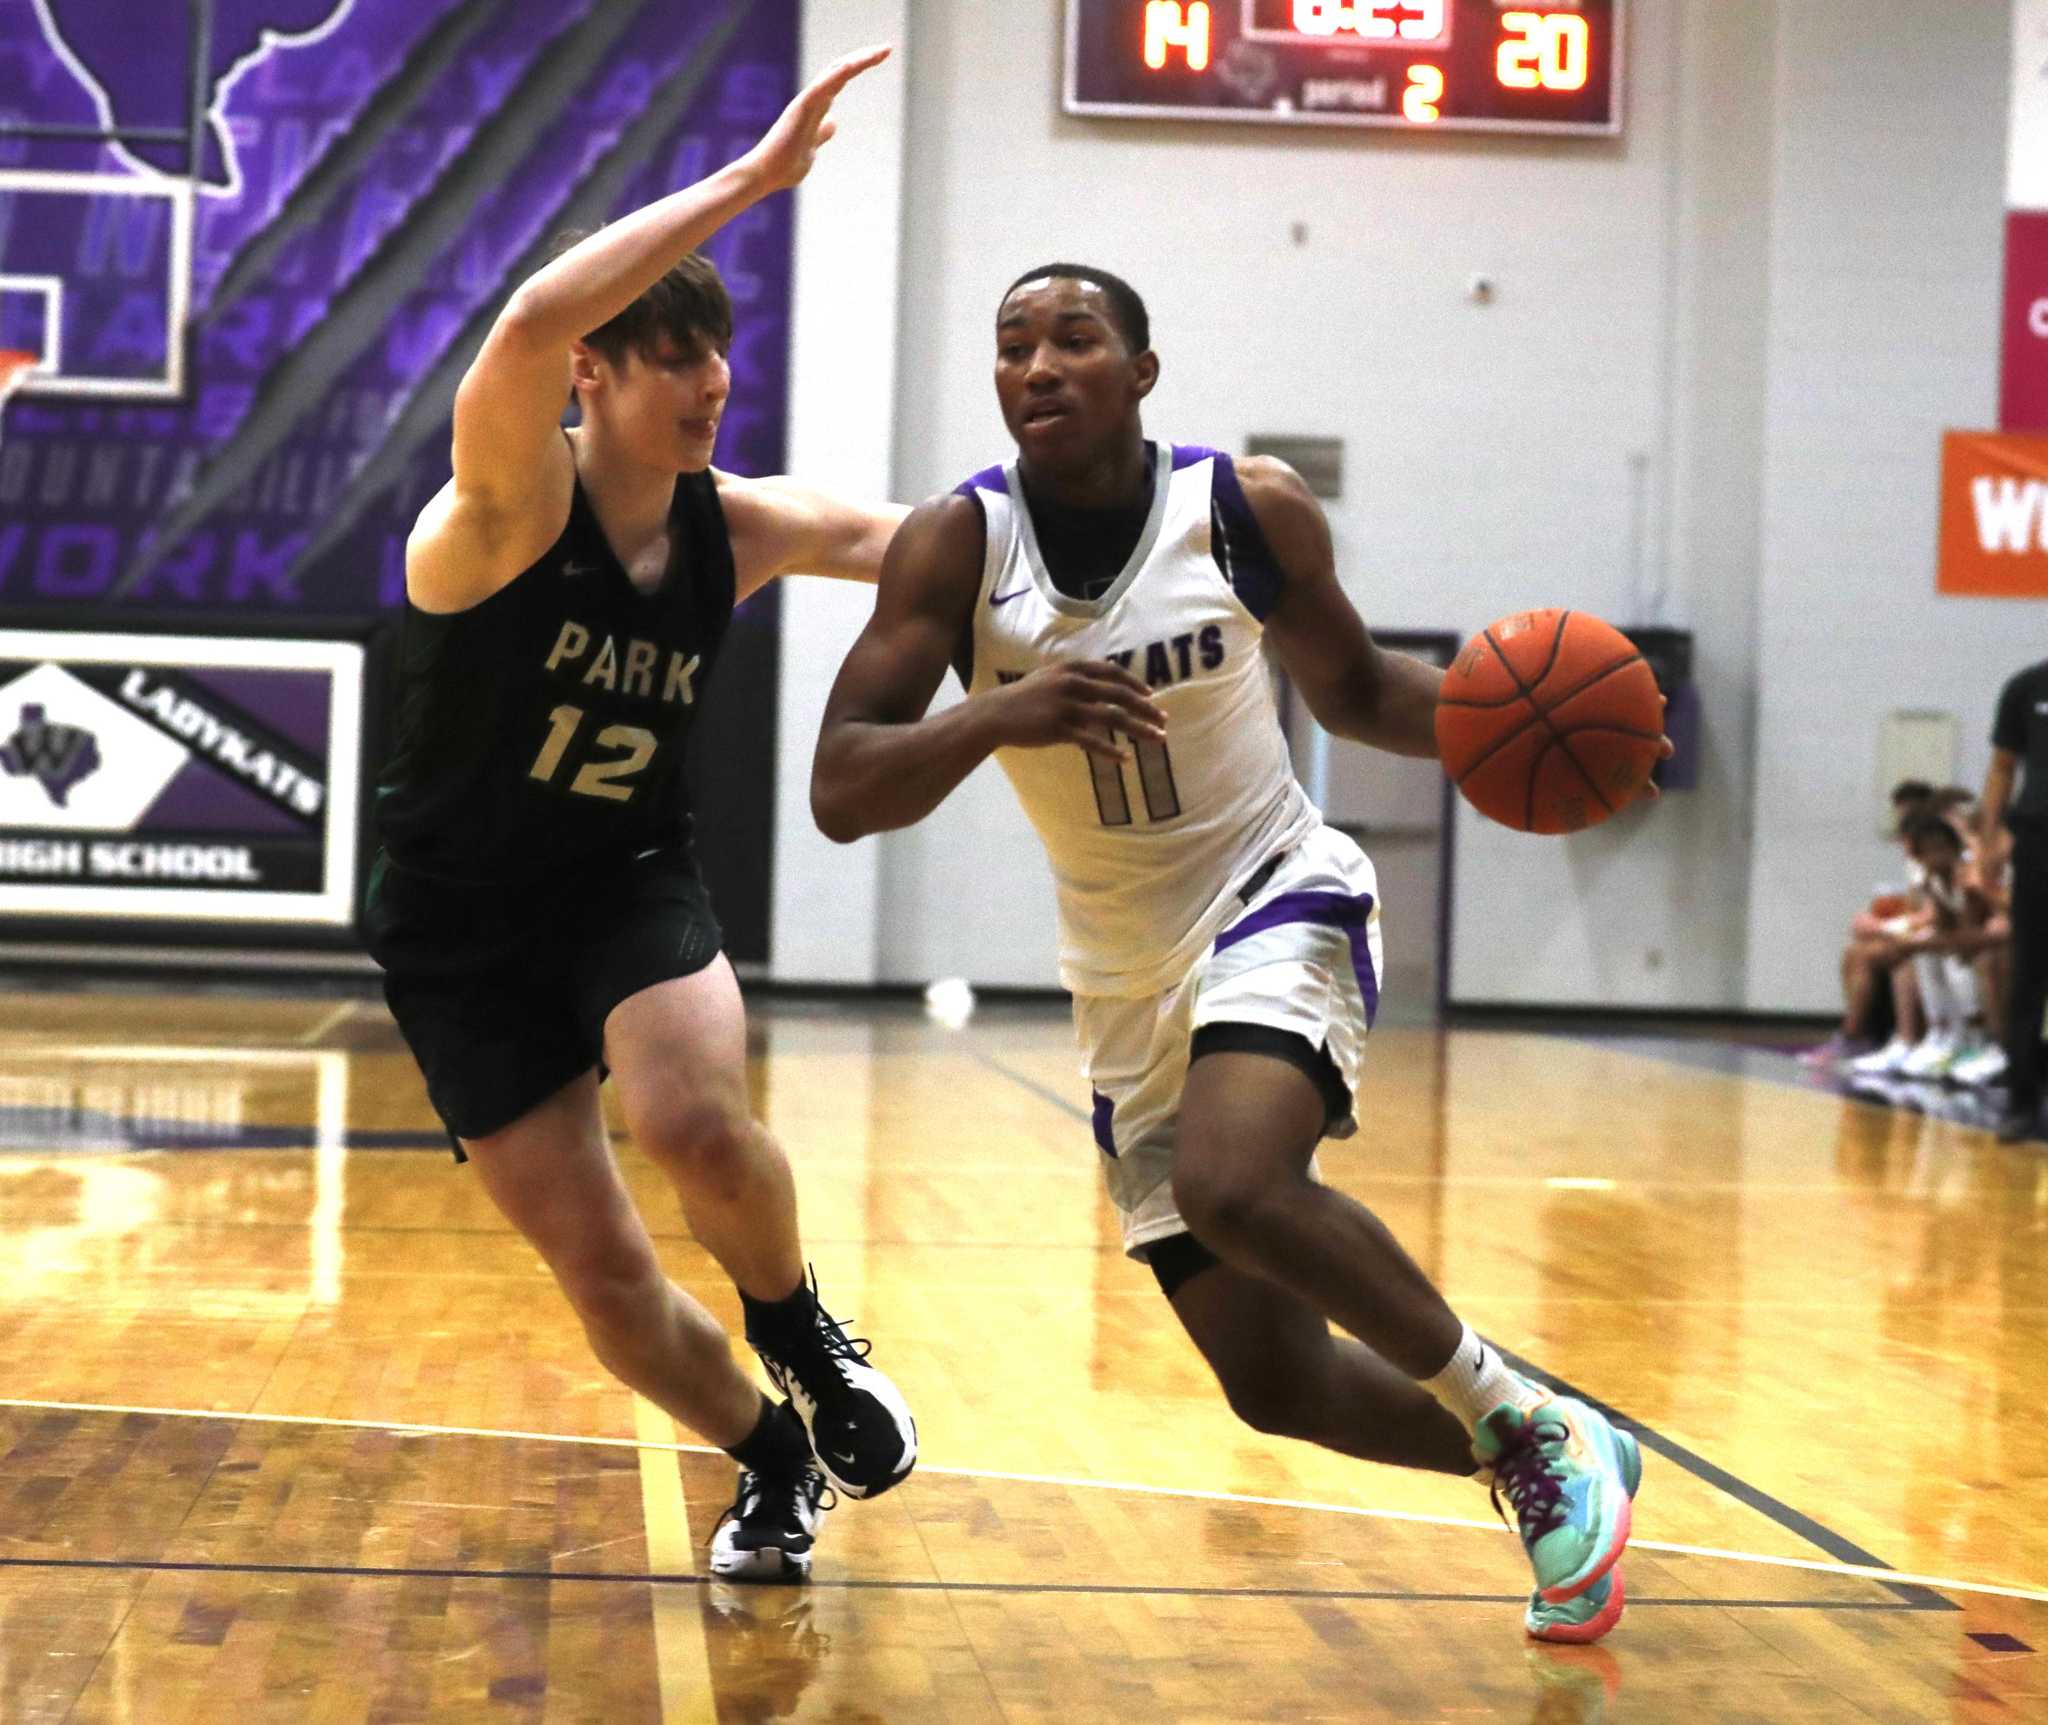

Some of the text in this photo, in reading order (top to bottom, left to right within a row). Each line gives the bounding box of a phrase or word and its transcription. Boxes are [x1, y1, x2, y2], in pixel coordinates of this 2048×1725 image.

[1144, 0, 1212, 71] 14
[1497, 11, 1589, 90] 20
[1403, 64, 1444, 123] 2
[544, 620, 701, 705] PARK
[528, 703, 658, 802] 12
[1085, 727, 1182, 826] 11
[90, 841, 262, 882] SCHOOL
